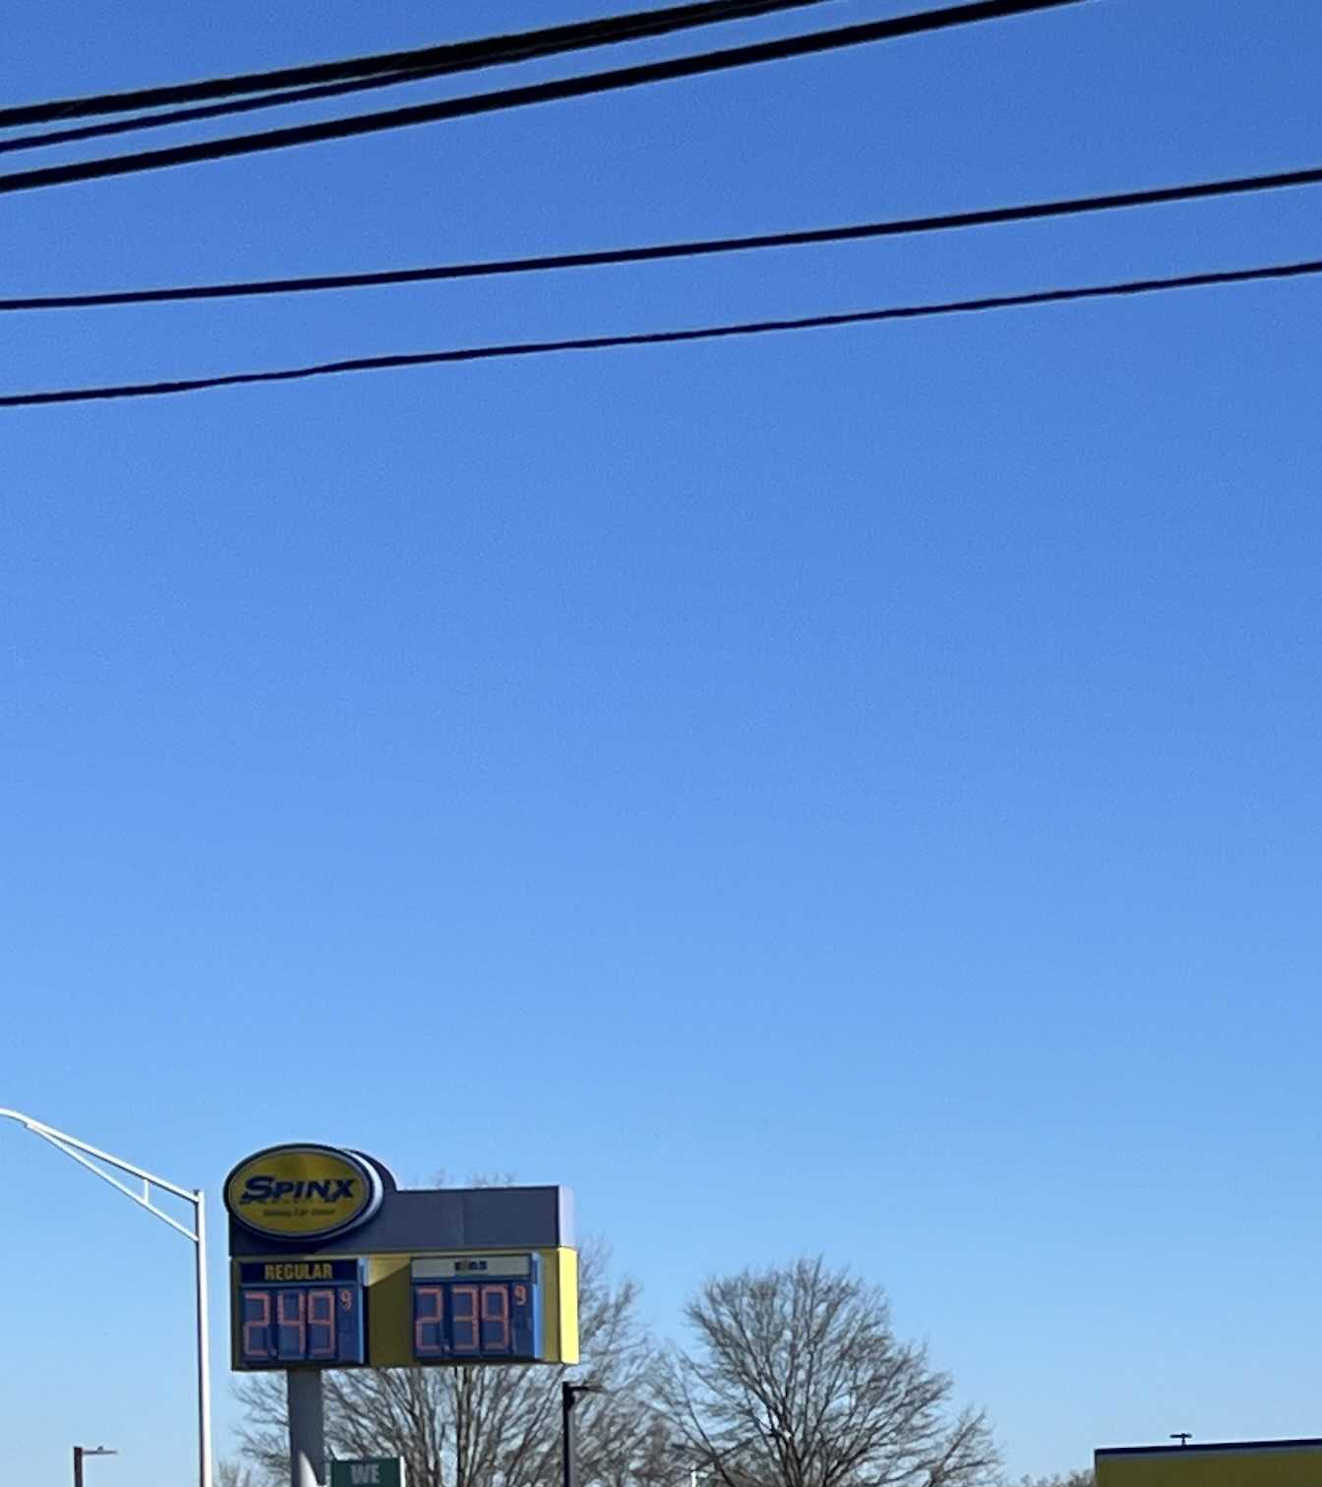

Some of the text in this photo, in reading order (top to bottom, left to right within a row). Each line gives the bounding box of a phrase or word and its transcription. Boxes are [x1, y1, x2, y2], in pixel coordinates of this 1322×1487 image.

[240, 1175, 354, 1203] SPINX
[264, 1263, 333, 1280] REGULAR
[351, 1463, 380, 1485] WE
